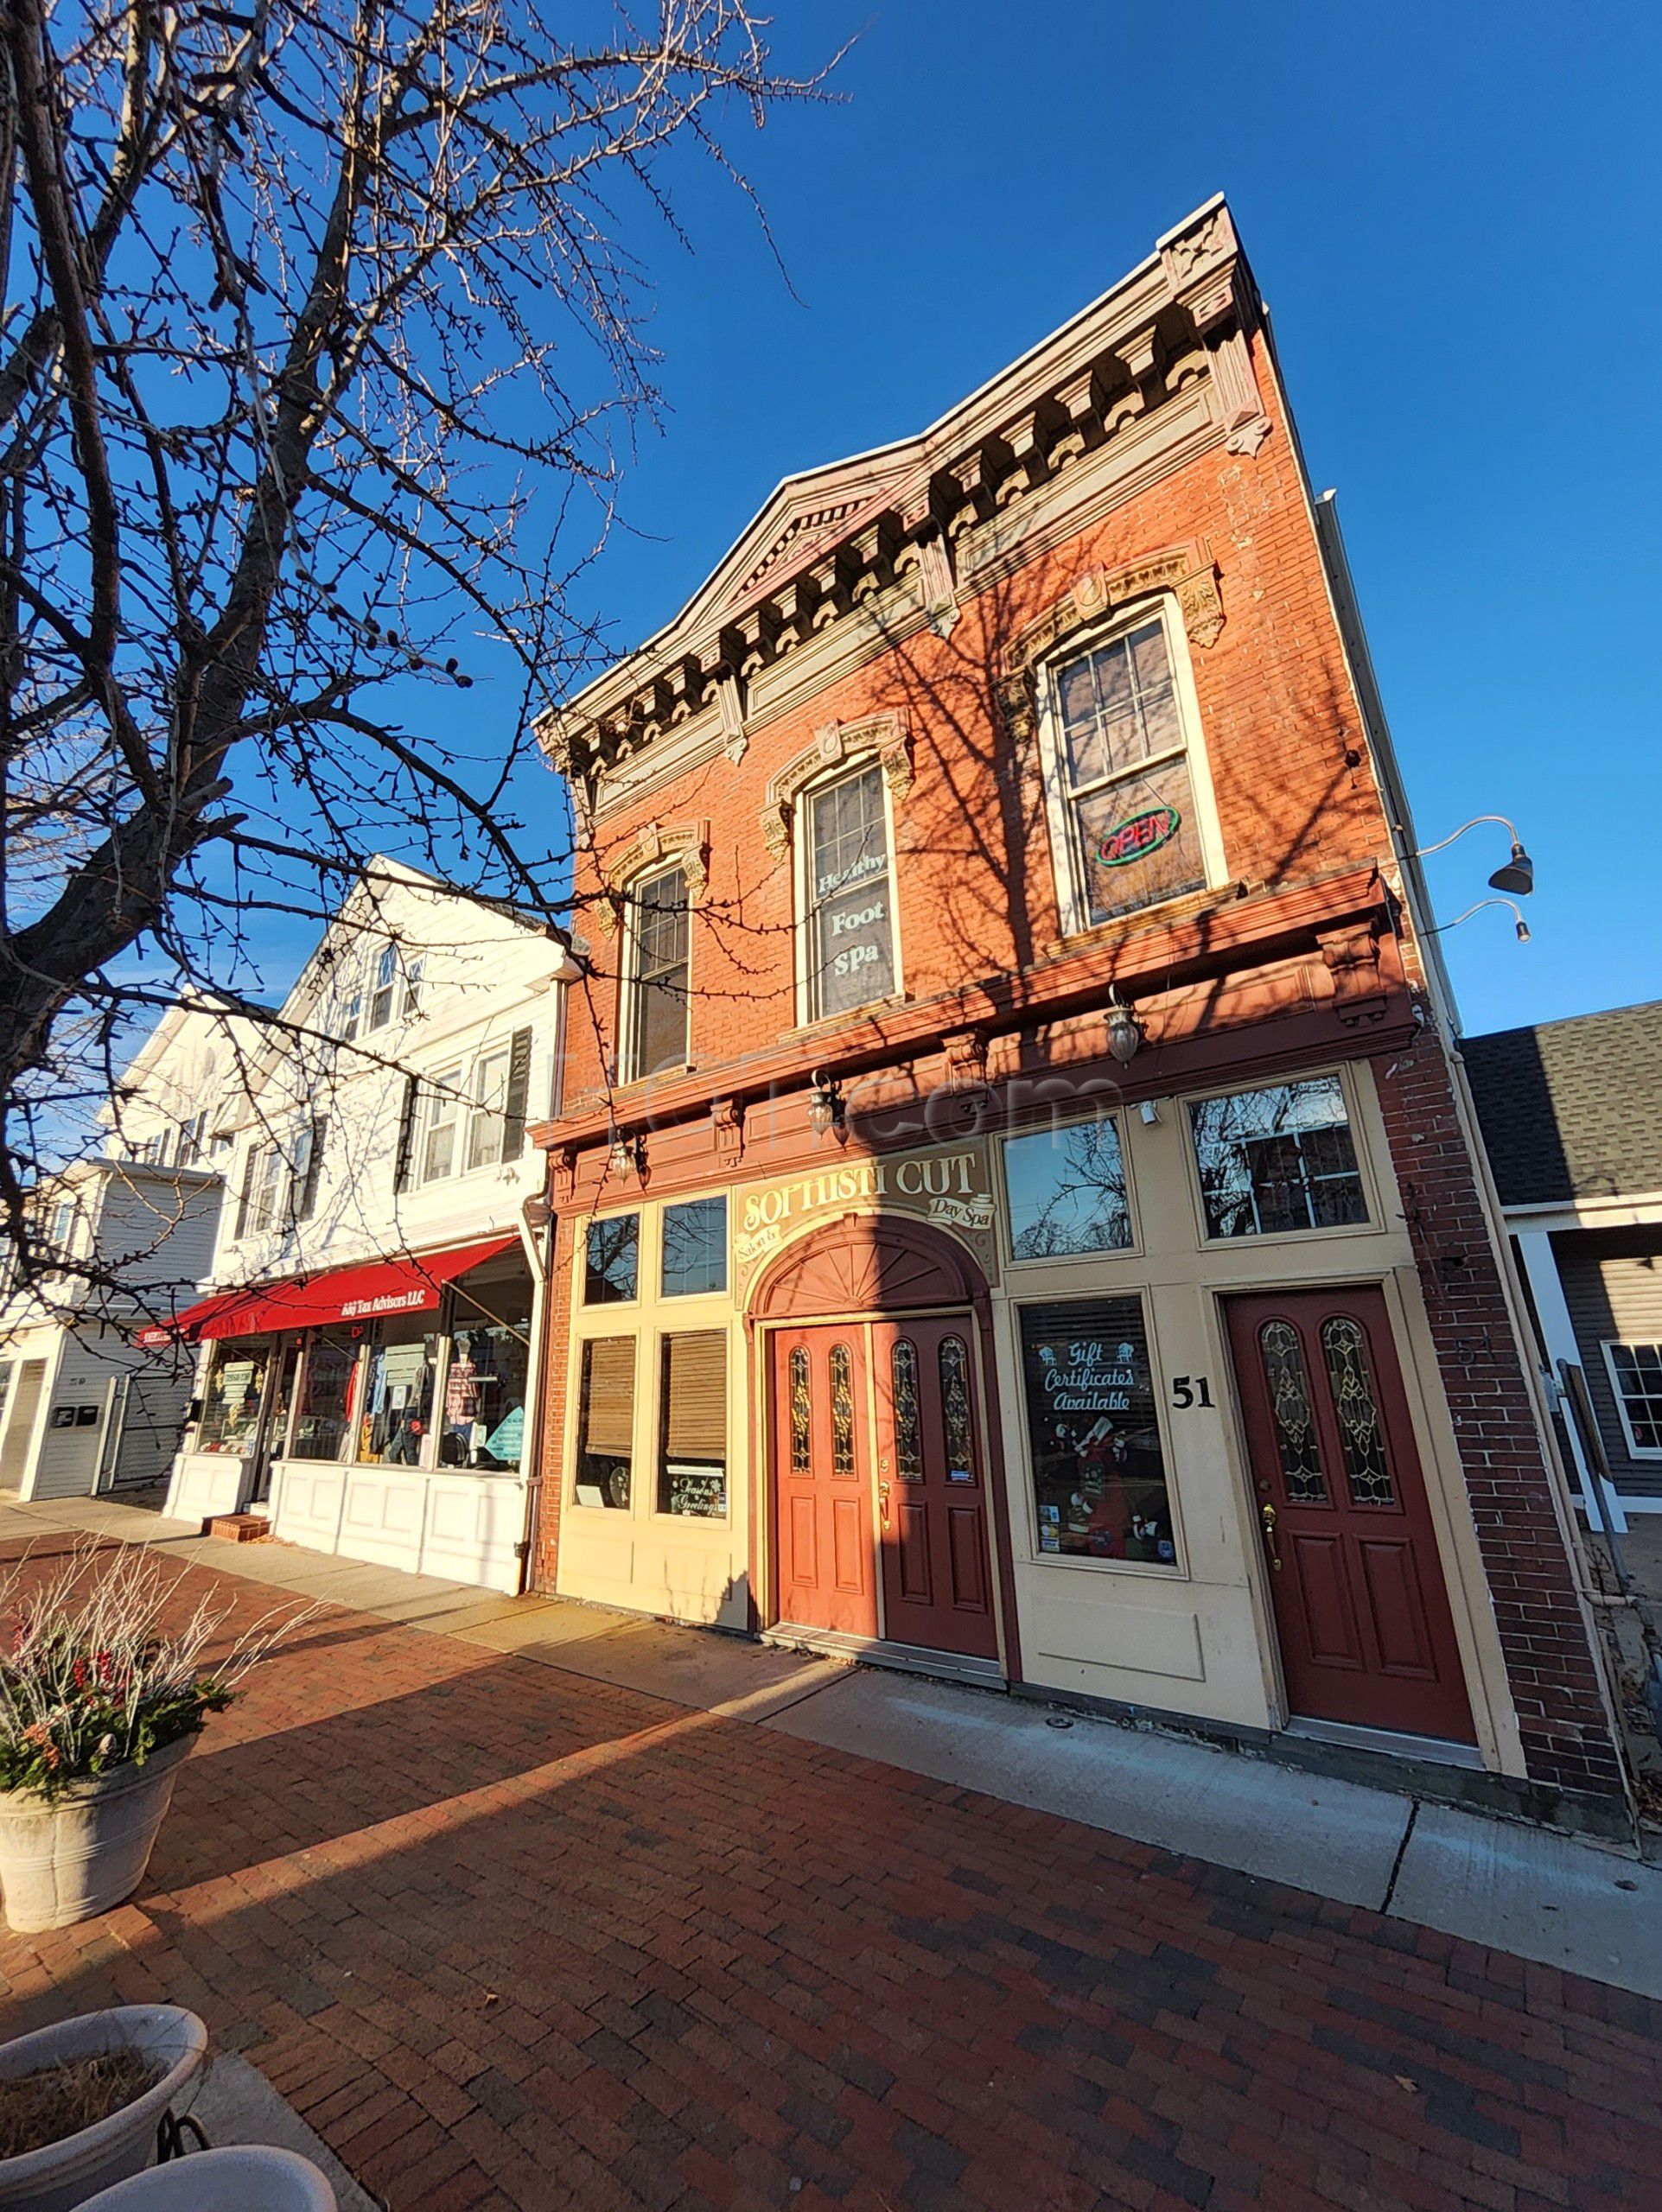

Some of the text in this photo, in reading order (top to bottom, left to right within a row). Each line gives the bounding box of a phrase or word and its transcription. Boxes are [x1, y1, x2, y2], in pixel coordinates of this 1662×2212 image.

[1100, 809, 1169, 861] OPEN
[818, 854, 887, 893] Healthy
[831, 900, 885, 937] Foot
[895, 1152, 977, 1195] CUT
[933, 1198, 990, 1227] Day Spa
[372, 1294, 407, 1312] Advisors
[407, 1289, 425, 1306] LLC
[1067, 1343, 1104, 1368] Gift
[1044, 1368, 1135, 1392] Certificates
[1172, 1376, 1216, 1409] 51
[1054, 1390, 1130, 1411] Available
